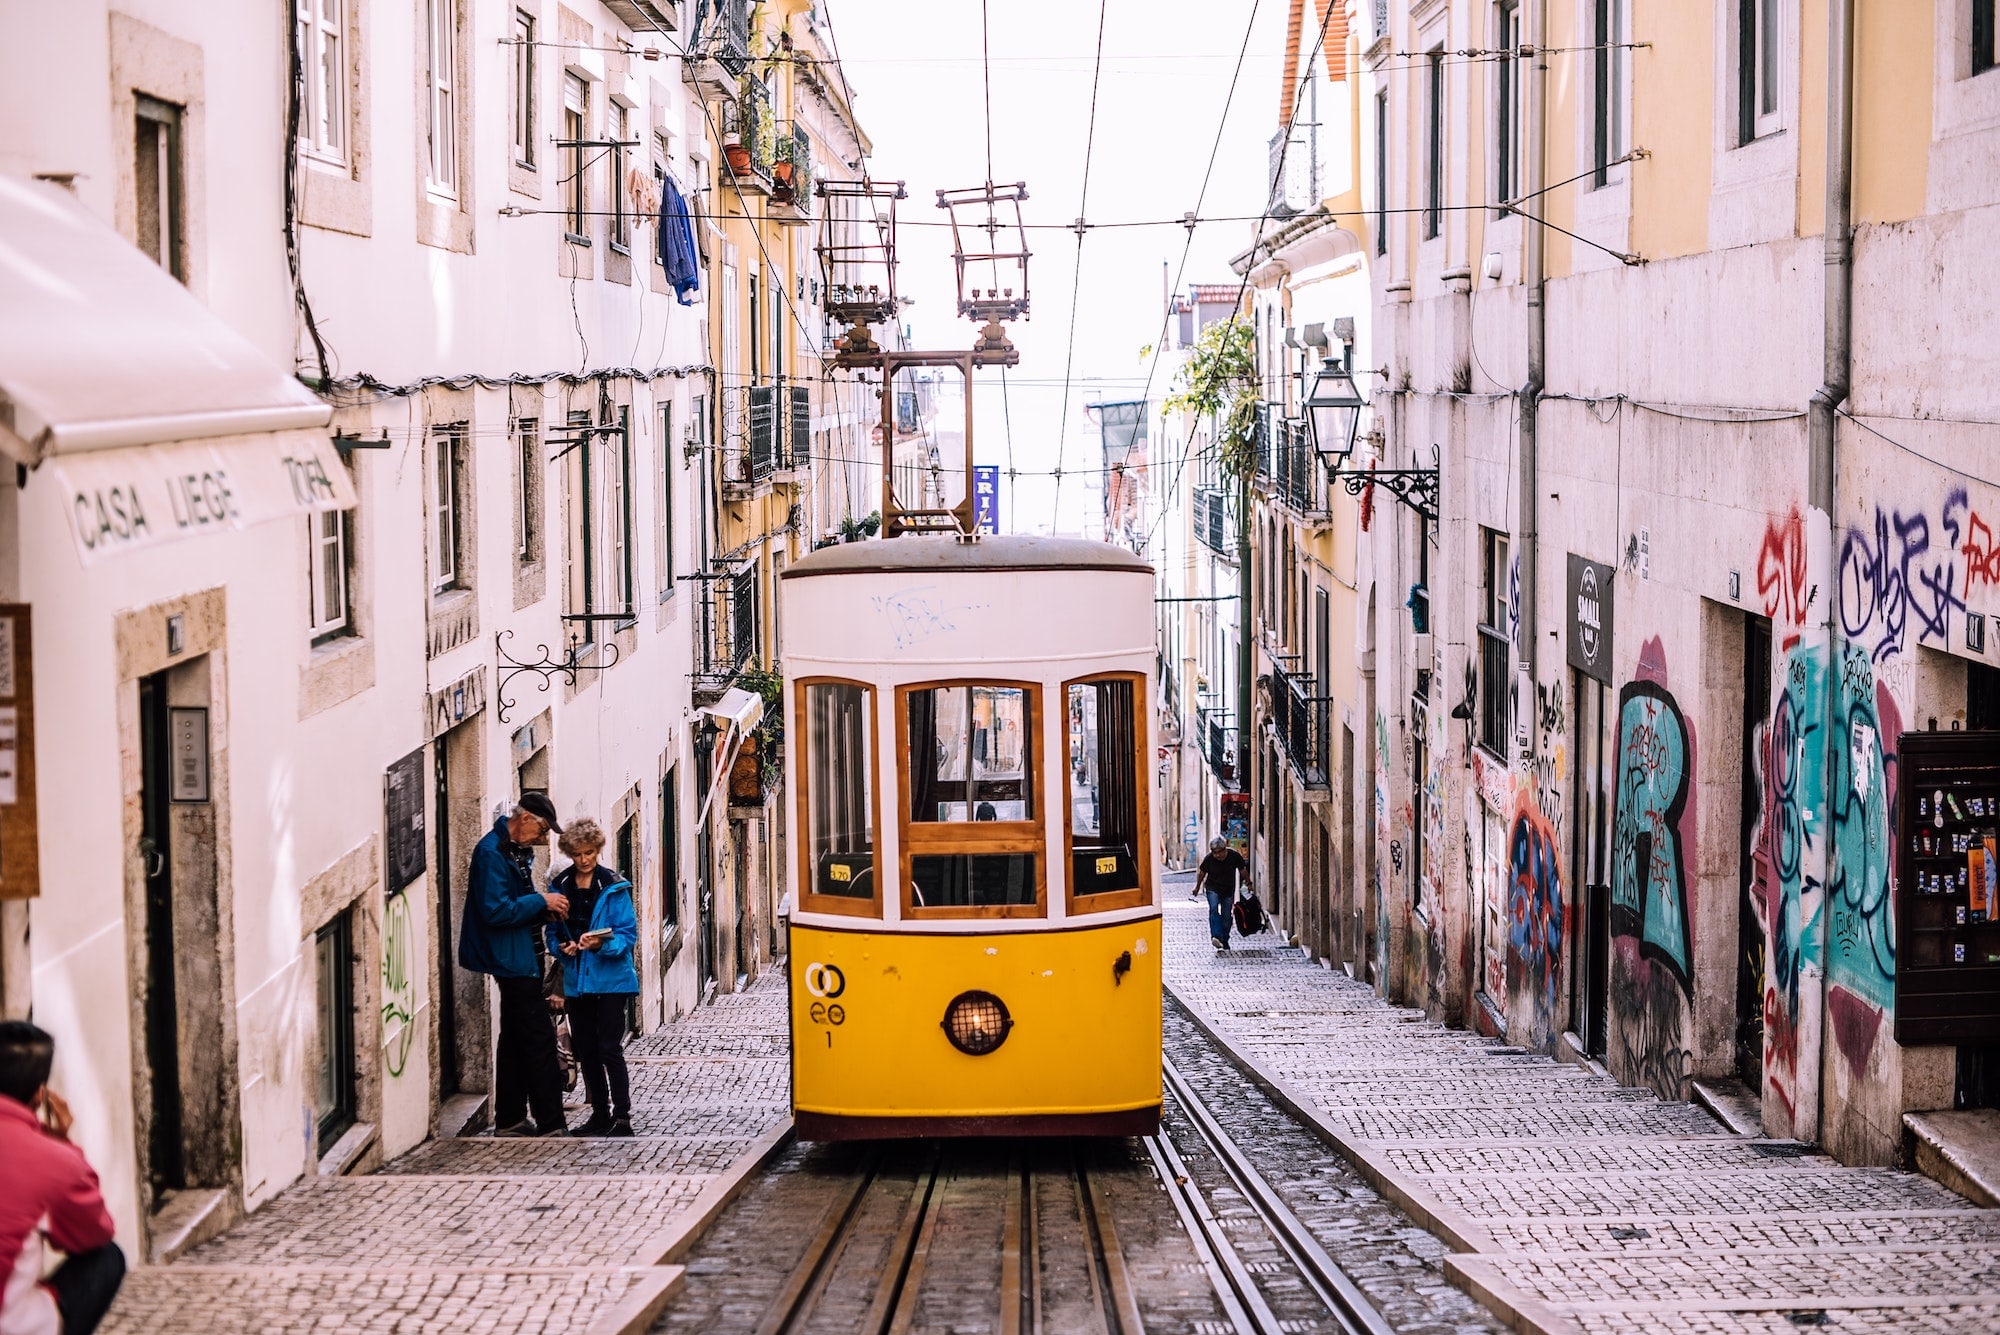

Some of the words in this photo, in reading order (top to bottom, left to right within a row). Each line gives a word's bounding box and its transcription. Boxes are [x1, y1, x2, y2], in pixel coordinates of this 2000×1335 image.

[74, 484, 150, 550] CASA
[166, 470, 239, 528] LIEGE
[1578, 595, 1600, 630] SMALL
[1968, 615, 1979, 648] 81
[826, 1030, 832, 1049] 1
